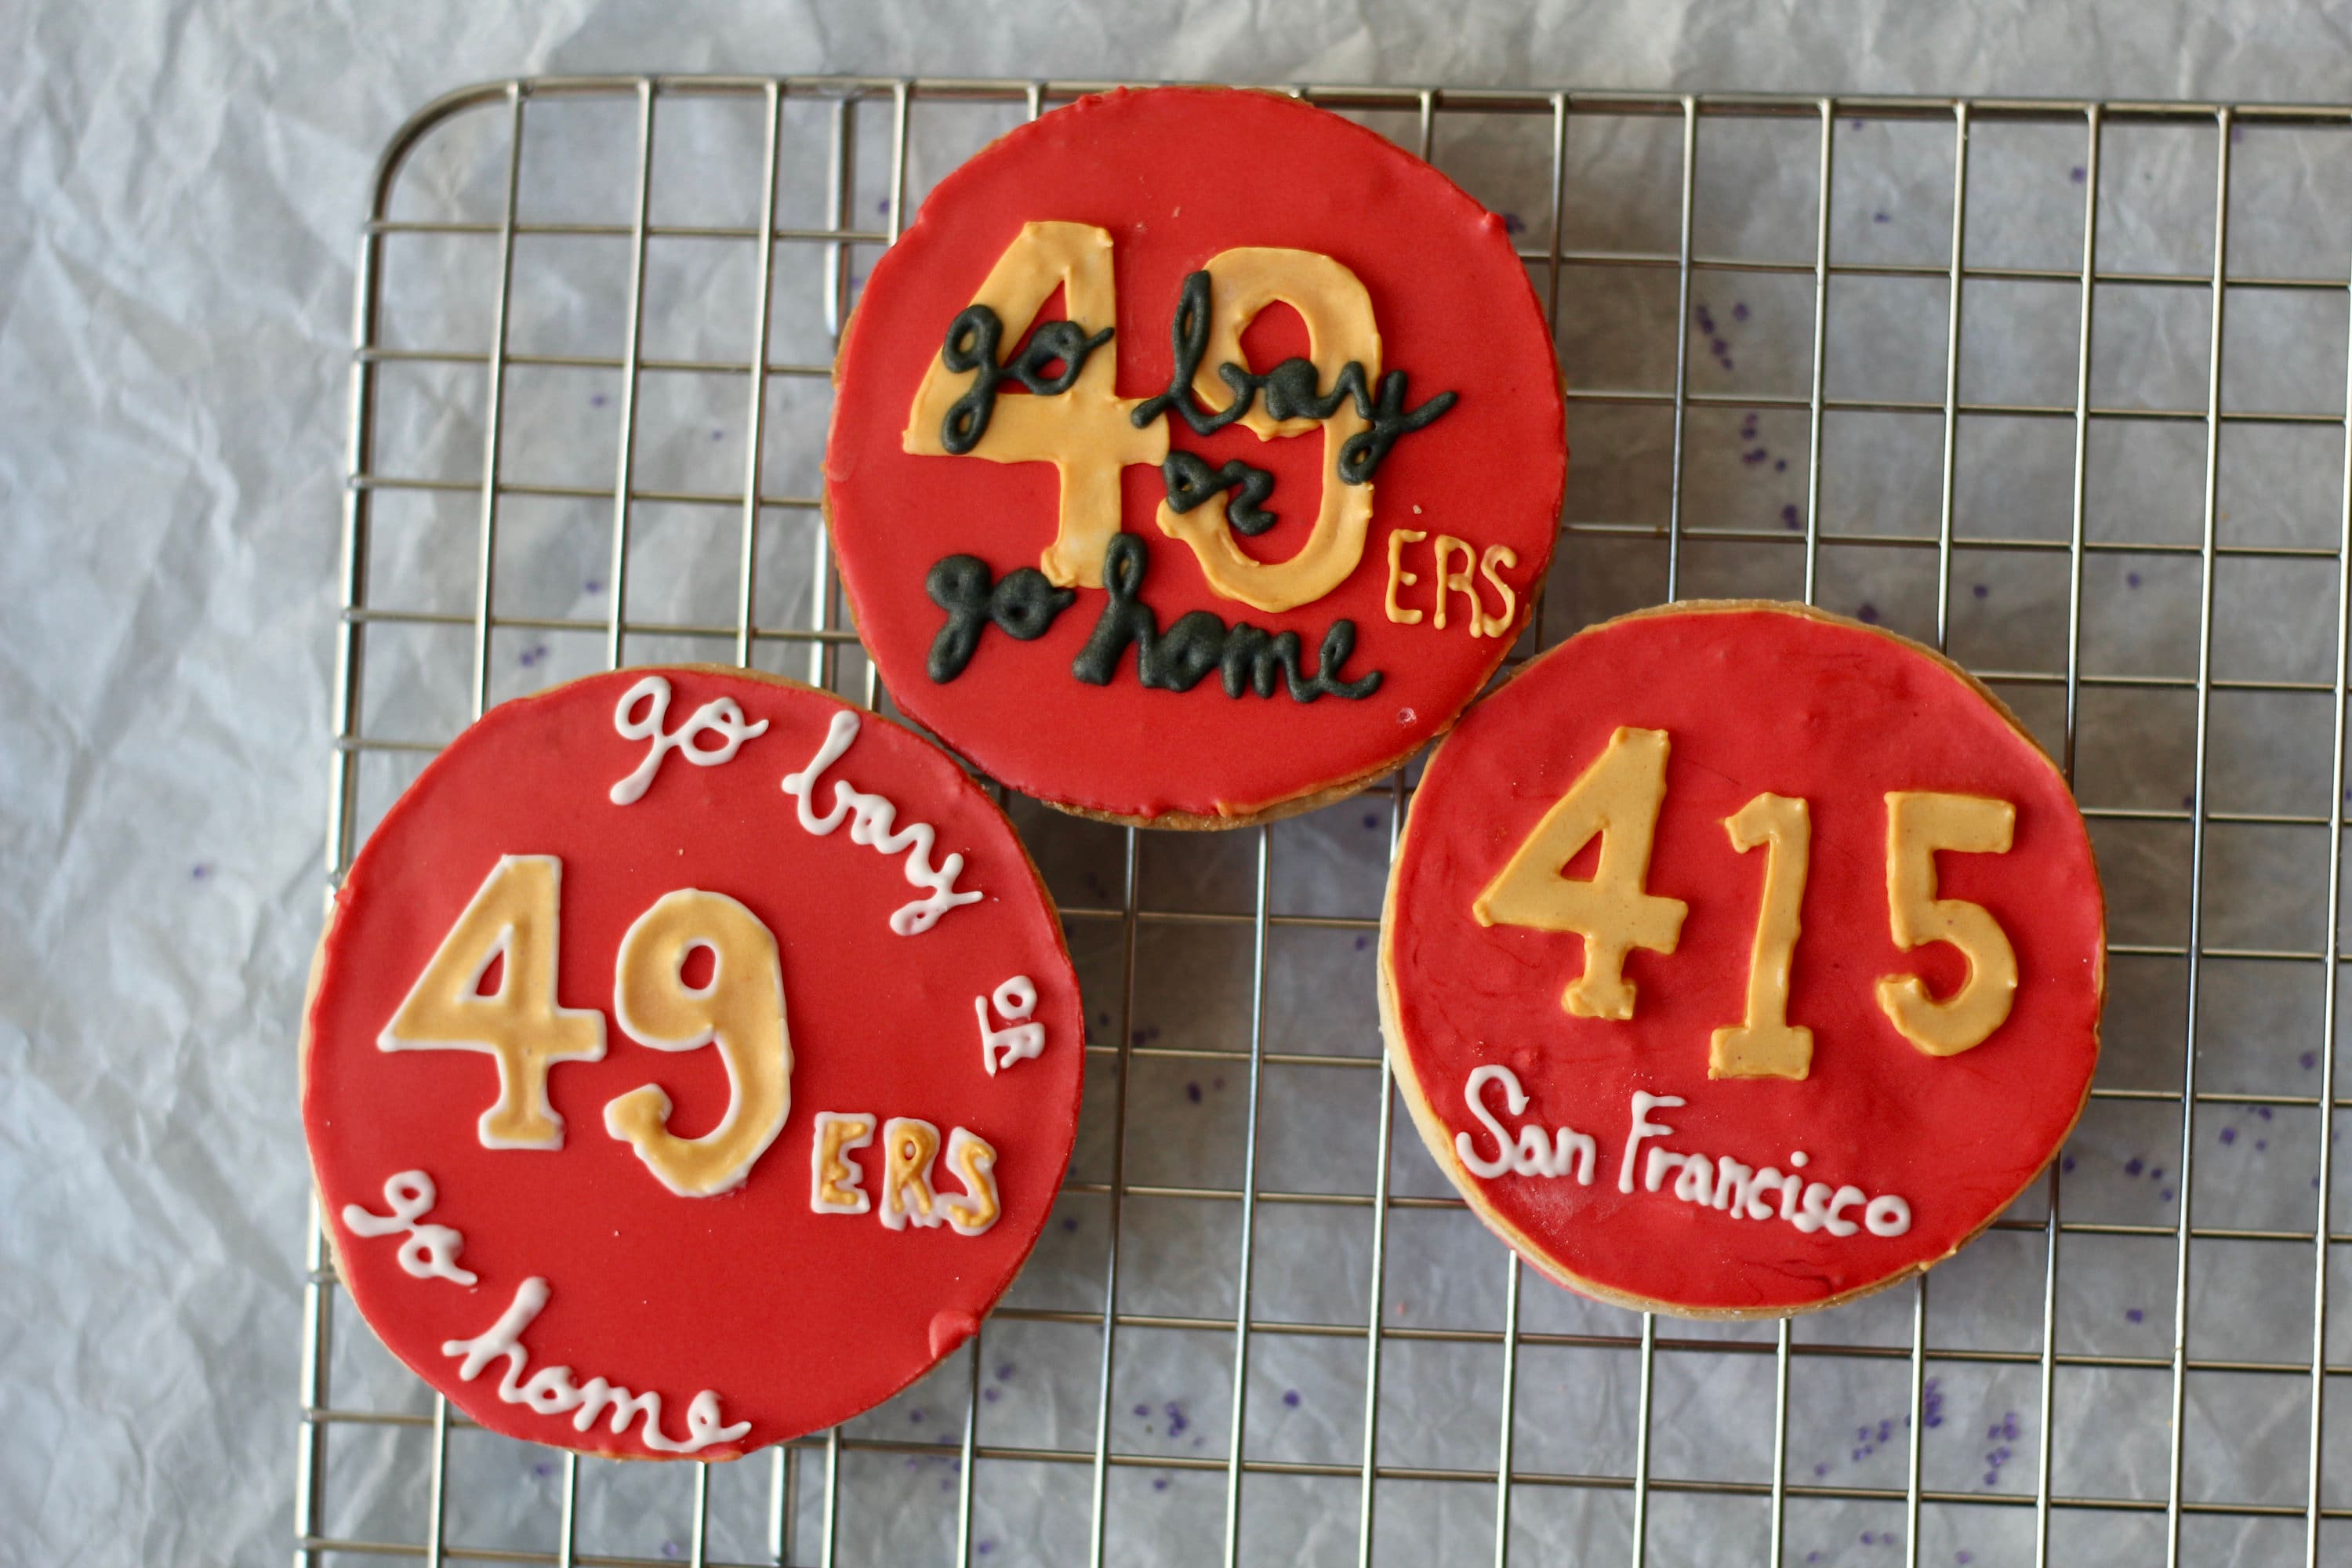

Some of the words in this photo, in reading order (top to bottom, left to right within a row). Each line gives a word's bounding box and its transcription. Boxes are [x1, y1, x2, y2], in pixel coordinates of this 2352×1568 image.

[903, 221, 1381, 612] 49
[1385, 528, 1516, 637] ERS
[942, 304, 1114, 454] go
[1131, 270, 1458, 485] bay
[927, 554, 1076, 684] go
[1072, 533, 1384, 702] home
[610, 676, 768, 805] go
[782, 711, 983, 935] bay
[1473, 726, 2017, 1080] 415
[377, 855, 793, 1197] 49
[811, 1112, 999, 1236] ERS
[1455, 1065, 1595, 1185] San
[1619, 1091, 1911, 1236] Francisco
[343, 1170, 477, 1285] go
[442, 1276, 751, 1452] home
